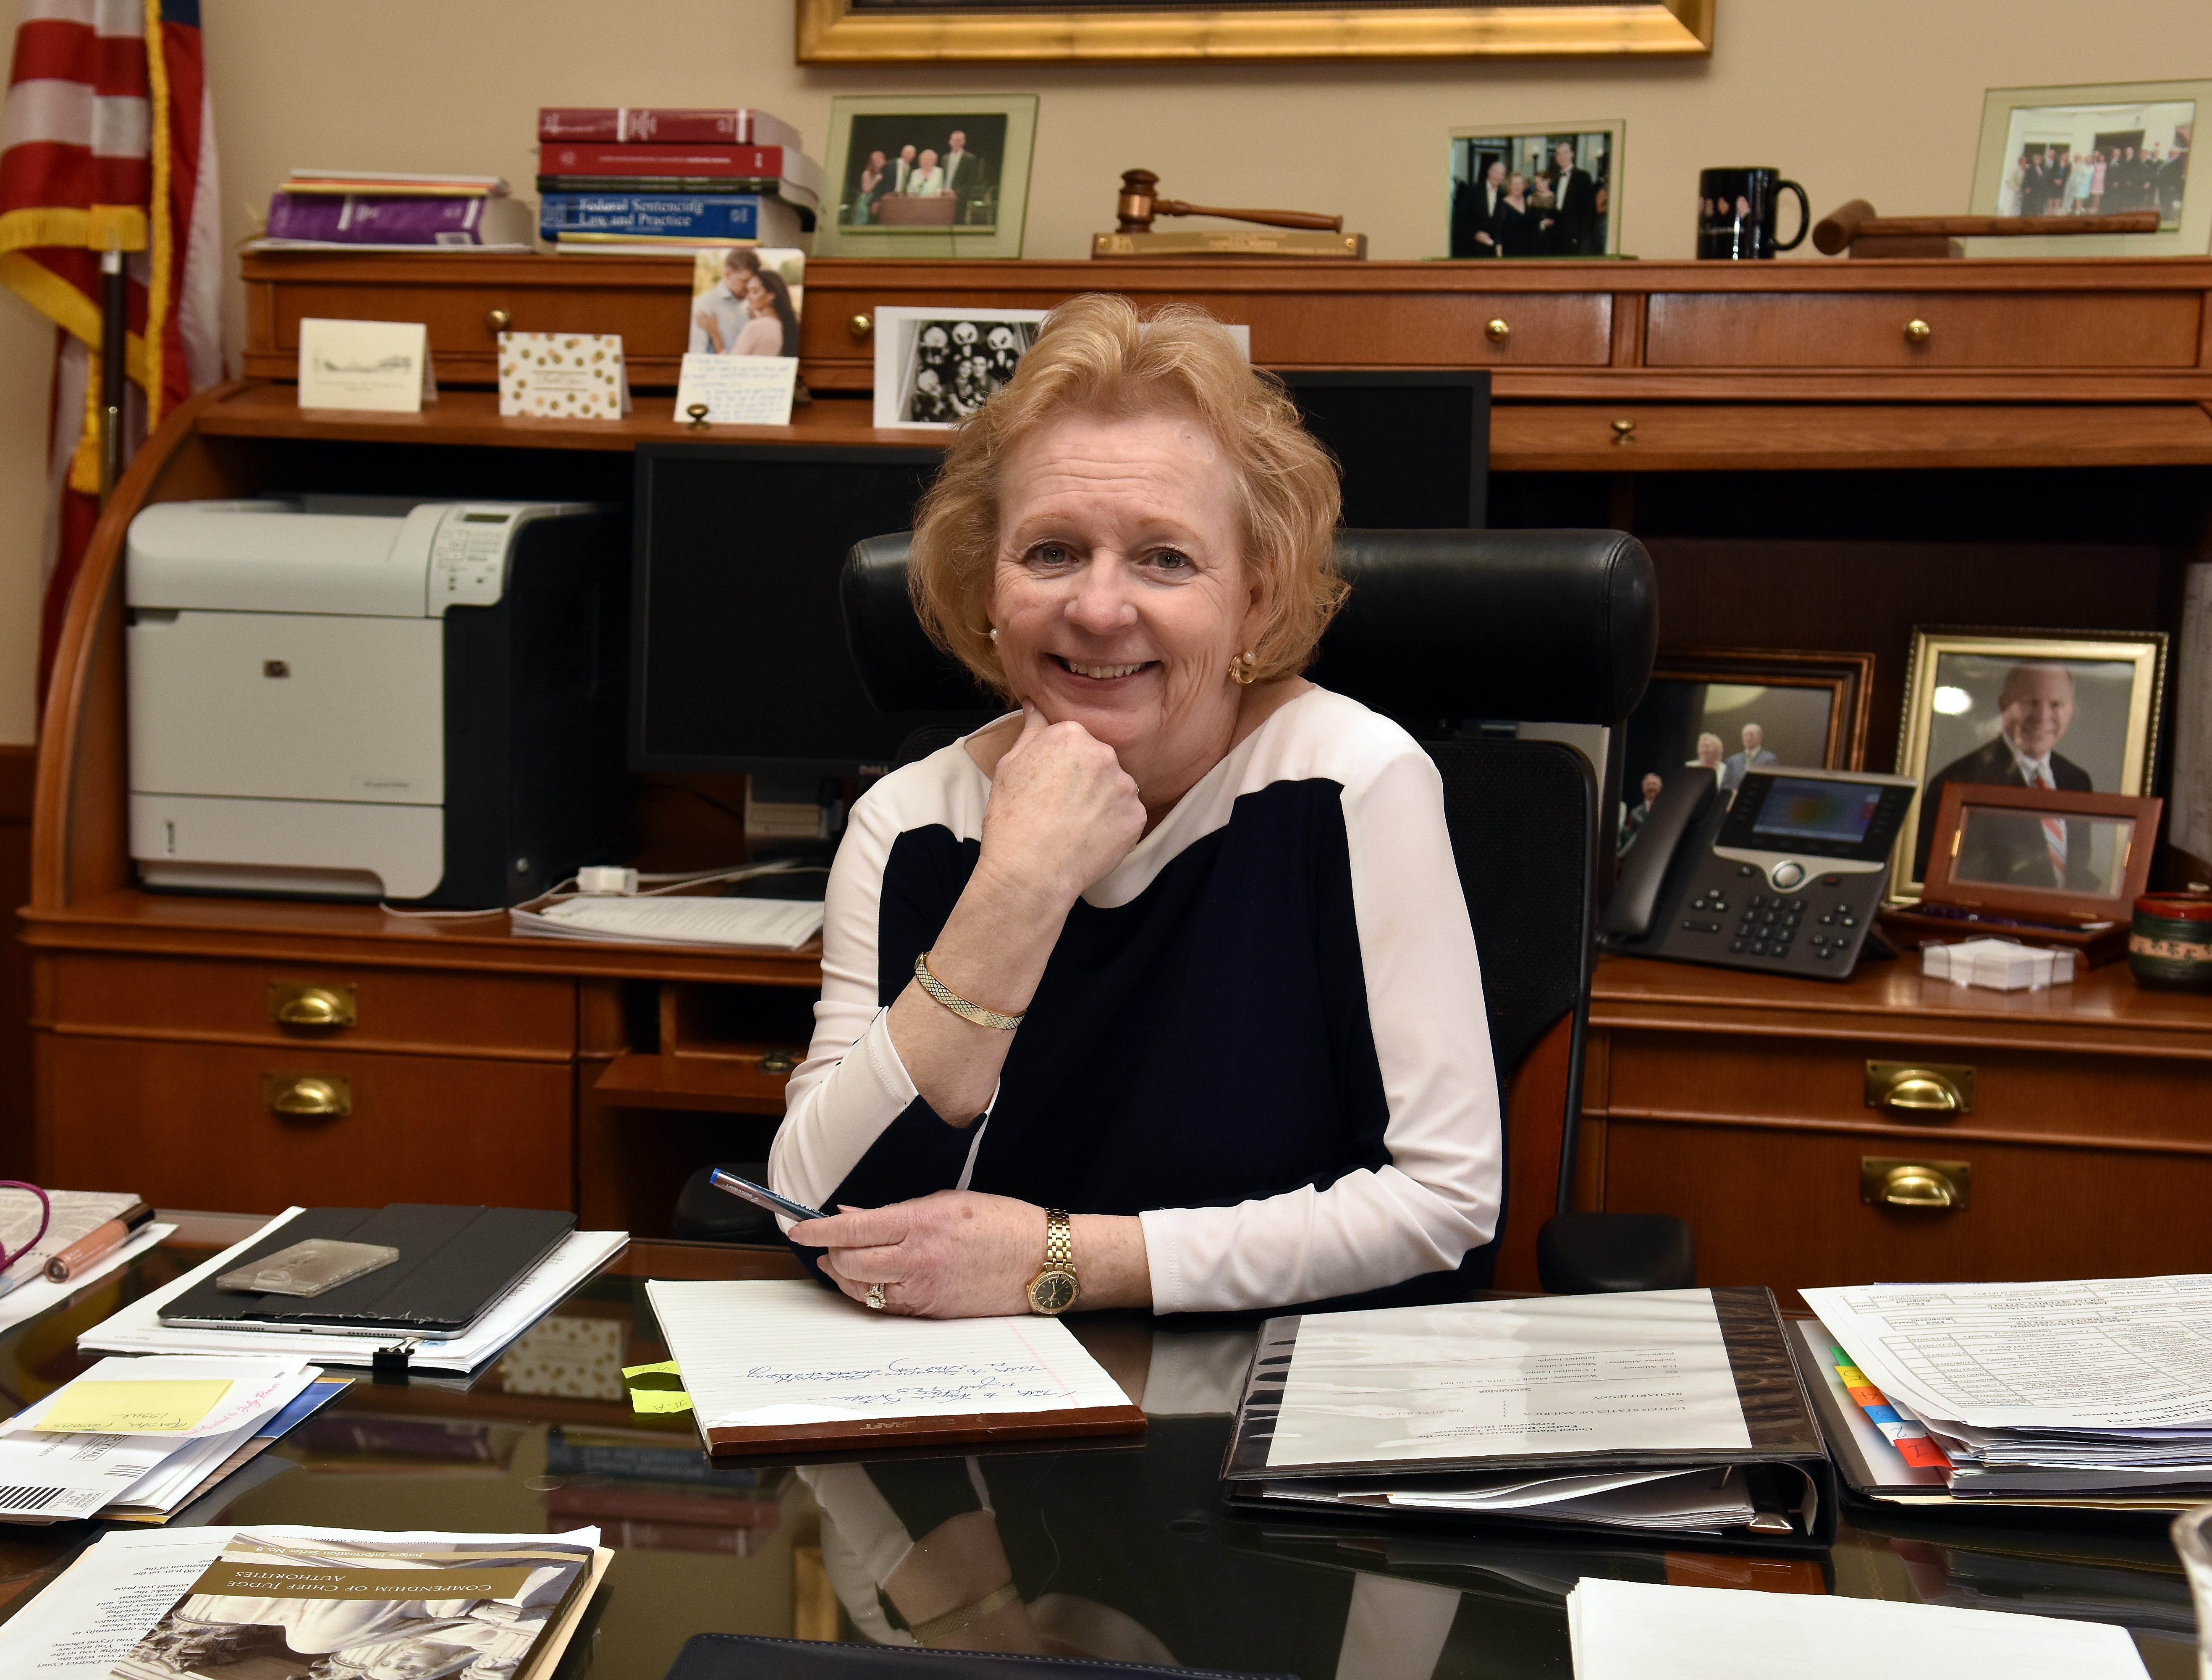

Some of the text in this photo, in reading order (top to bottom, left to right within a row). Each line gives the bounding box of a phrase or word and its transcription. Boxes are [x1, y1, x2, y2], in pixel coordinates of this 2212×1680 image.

[611, 212, 635, 225] and
[725, 1184, 753, 1198] SKILCRAFT
[1843, 1370, 1862, 1381] 5
[1861, 1391, 1877, 1401] 4
[2163, 1404, 2209, 1413] Database
[1876, 1410, 1893, 1419] 3
[2137, 1411, 2199, 1420] REFORM
[1890, 1426, 1907, 1438] 2
[38, 1442, 60, 1457] SOCIETY
[82, 1446, 105, 1460] MAIL
[234, 1571, 347, 1582] AUTHORITIES
[225, 1580, 282, 1590] JUDGE
[286, 1583, 339, 1592] CHIEF
